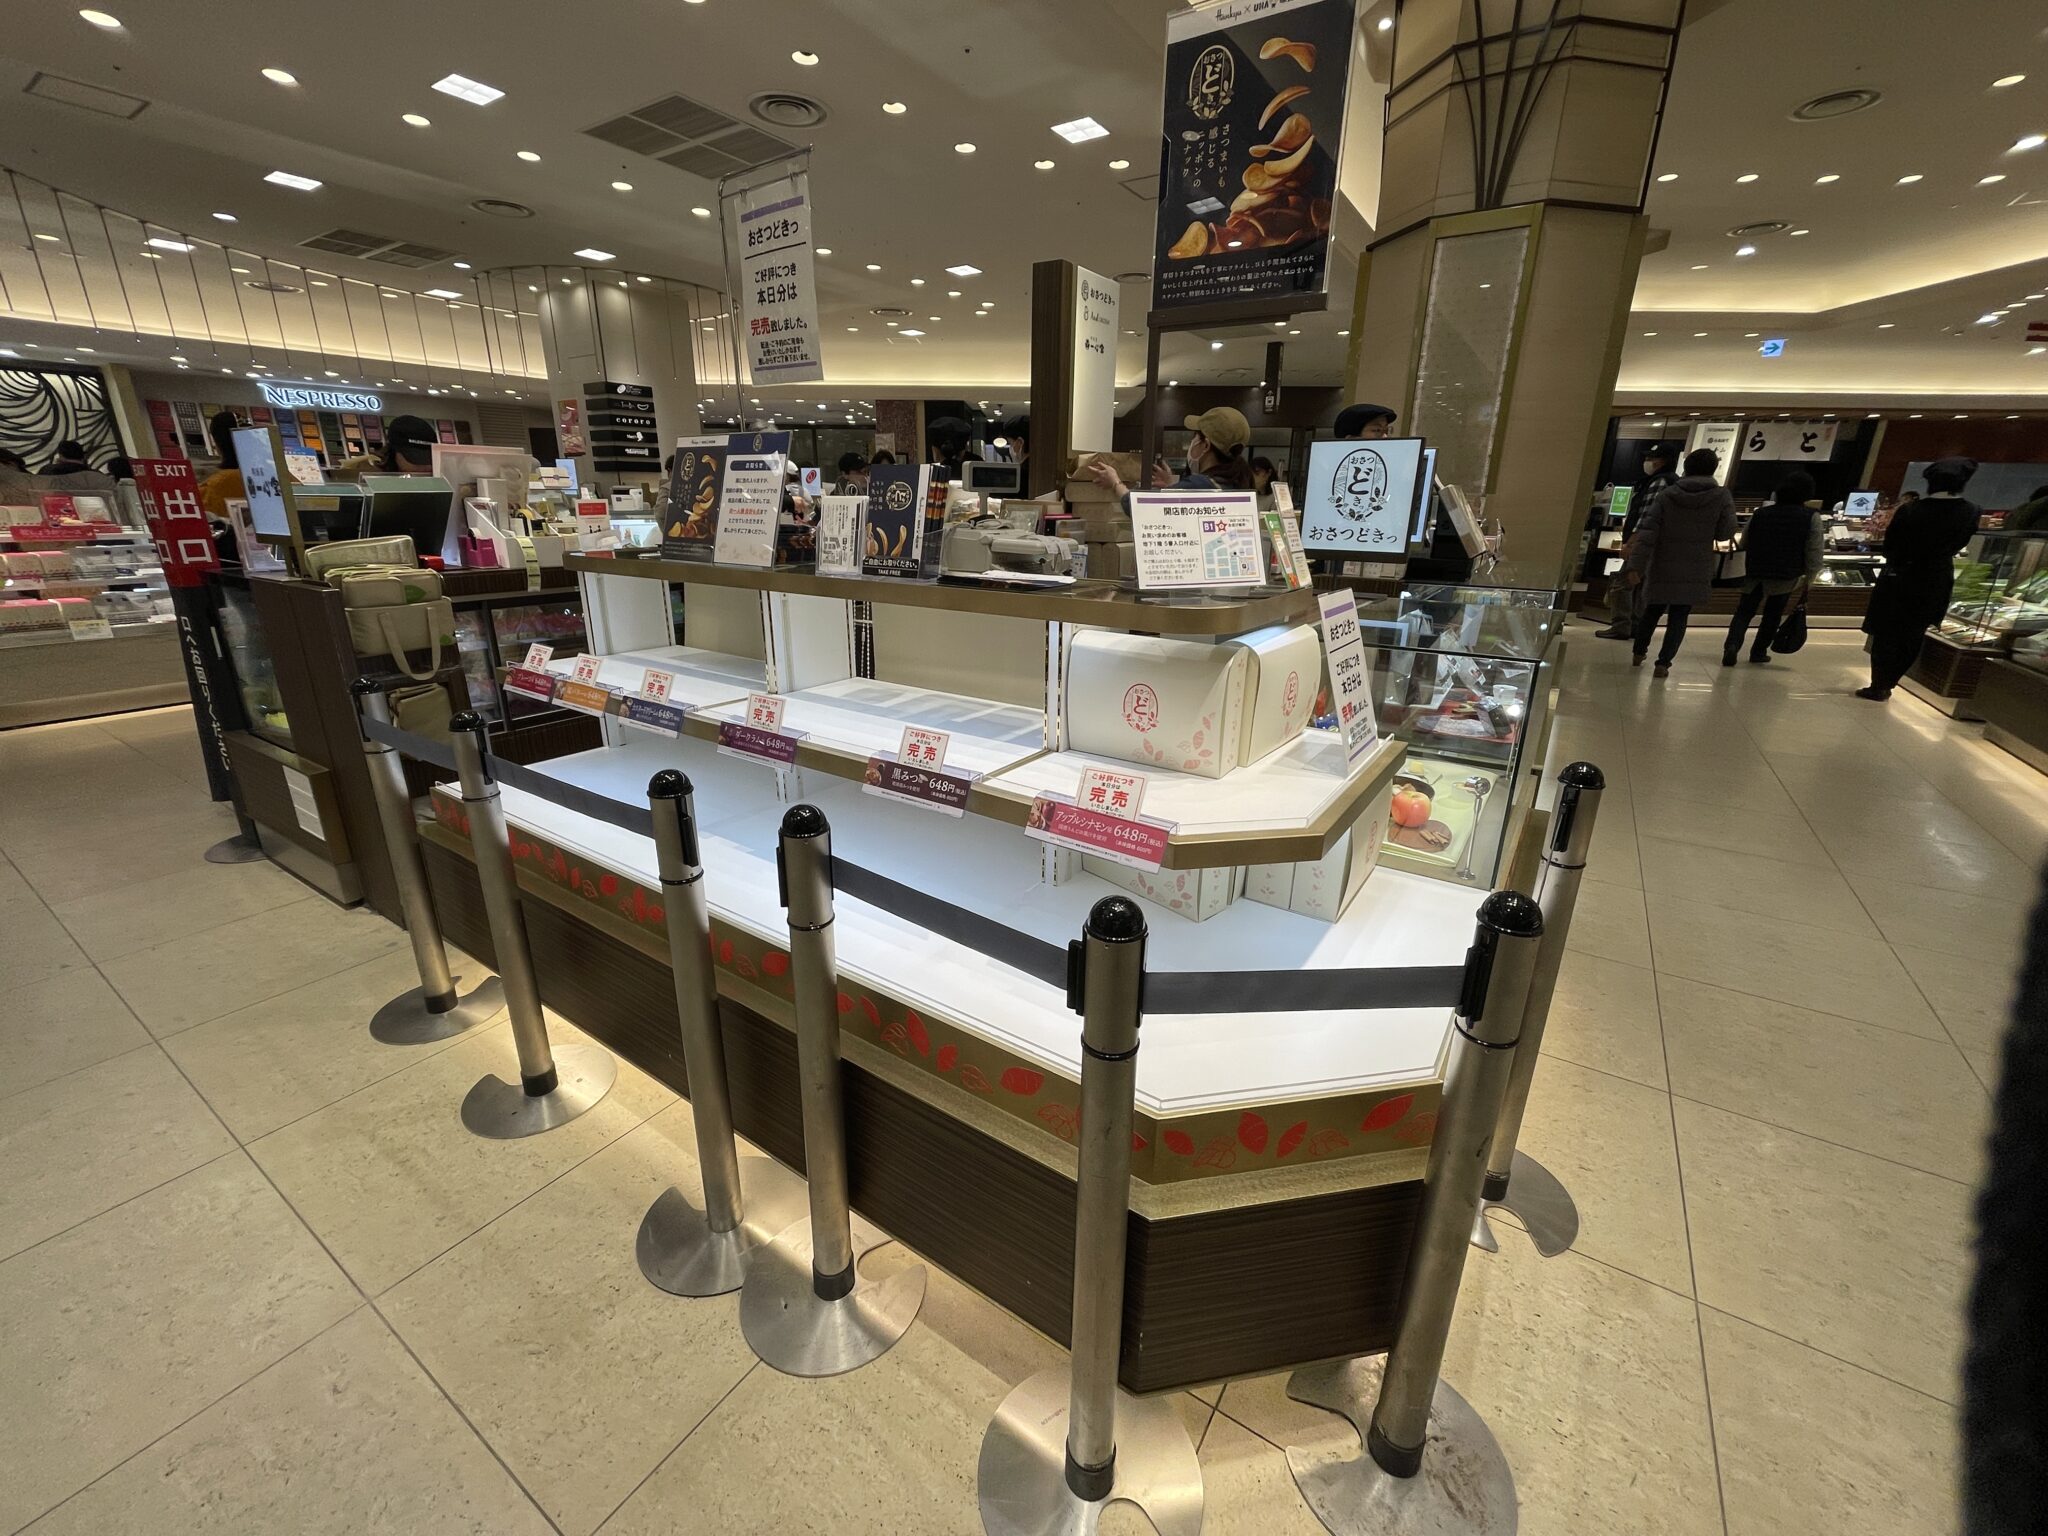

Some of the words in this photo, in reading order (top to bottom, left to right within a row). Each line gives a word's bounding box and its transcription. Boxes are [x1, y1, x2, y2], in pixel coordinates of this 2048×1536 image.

[1219, 124, 1231, 188] さつまいも
[748, 219, 799, 247] おさつどきっ
[755, 263, 797, 283] ご好評につき
[757, 283, 798, 306] 本日分は
[751, 316, 808, 336] 完売致しました。
[260, 384, 381, 410] NESPRESSO
[616, 417, 650, 425] cororo
[1350, 456, 1375, 465] おさつ
[154, 464, 187, 477] EXIT
[1347, 466, 1374, 496] ど
[1164, 506, 1226, 516] 開店前のお知らせ
[163, 489, 212, 565] 出口
[1204, 523, 1214, 531] B1
[1308, 526, 1398, 544] おさつどきっ
[864, 558, 918, 569] ご自由にお取りください。
[1330, 619, 1355, 641] おさつどきっ
[646, 682, 665, 696] 完売
[753, 708, 776, 724] 完売
[909, 730, 942, 743] ご好評につき
[907, 743, 938, 762] 完売
[1091, 773, 1135, 786] ご好評につき
[1088, 786, 1129, 808] 完売
[1113, 825, 1164, 848] 648円(税込)
